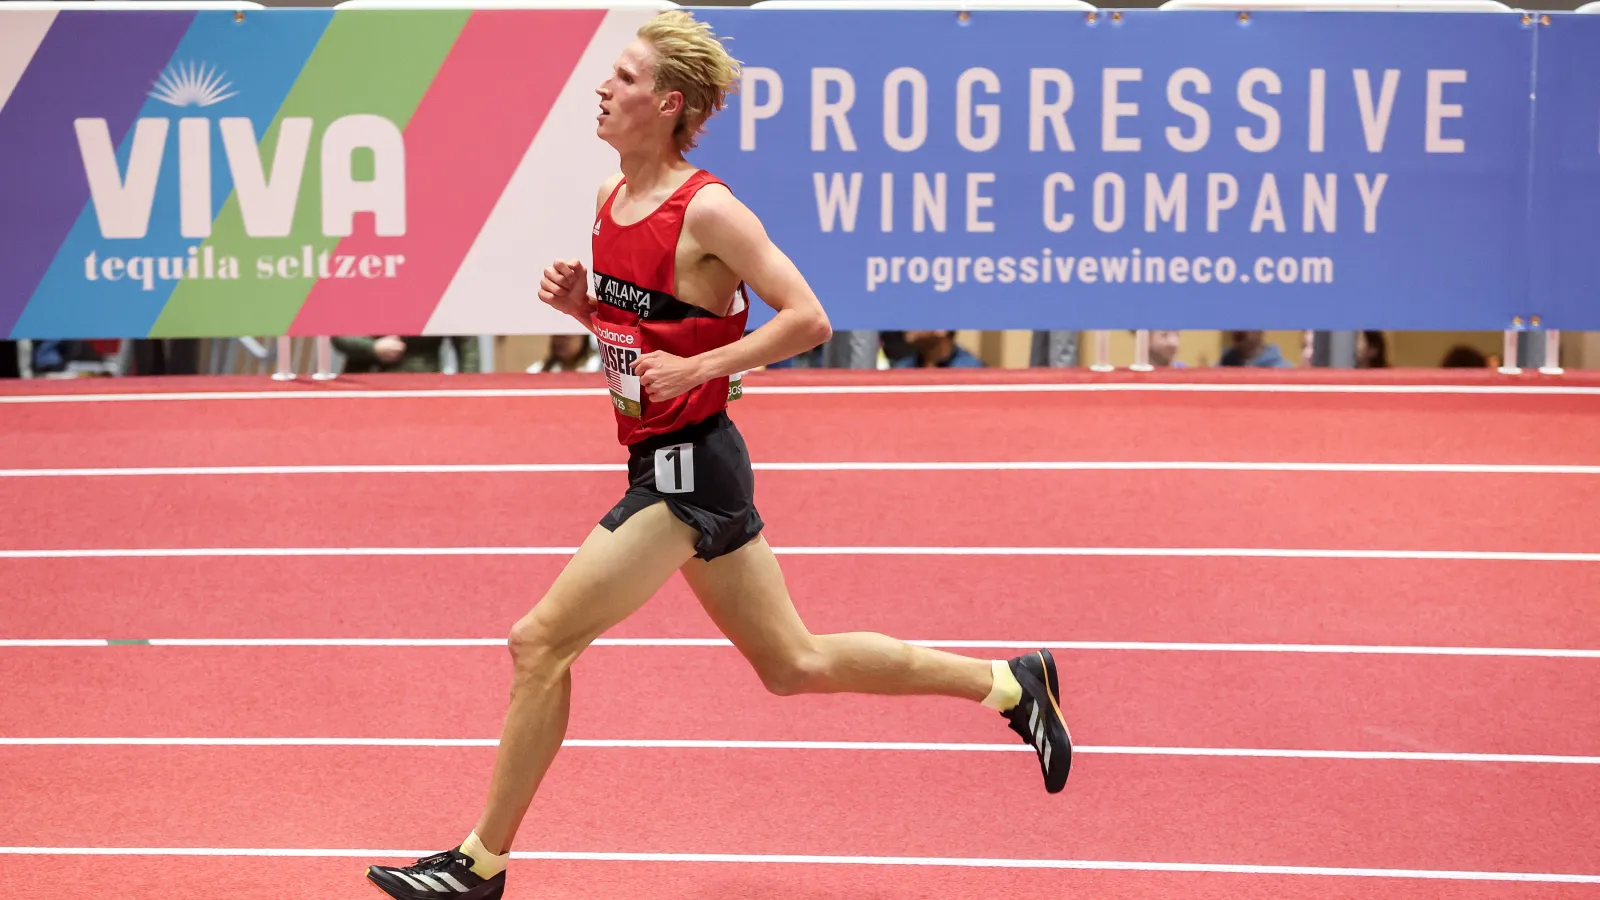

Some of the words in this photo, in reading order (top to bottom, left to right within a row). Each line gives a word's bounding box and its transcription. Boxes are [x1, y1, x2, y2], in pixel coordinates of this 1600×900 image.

[740, 66, 1467, 154] PROGRESSIVE
[74, 113, 407, 239] VIVA
[813, 172, 995, 232] WINE
[1043, 172, 1389, 233] COMPANY
[84, 245, 241, 291] tequila
[256, 245, 406, 279] seltzer
[867, 248, 1333, 292] progressivewineco.com
[605, 279, 650, 309] ATLANTA
[665, 446, 682, 490] 1
